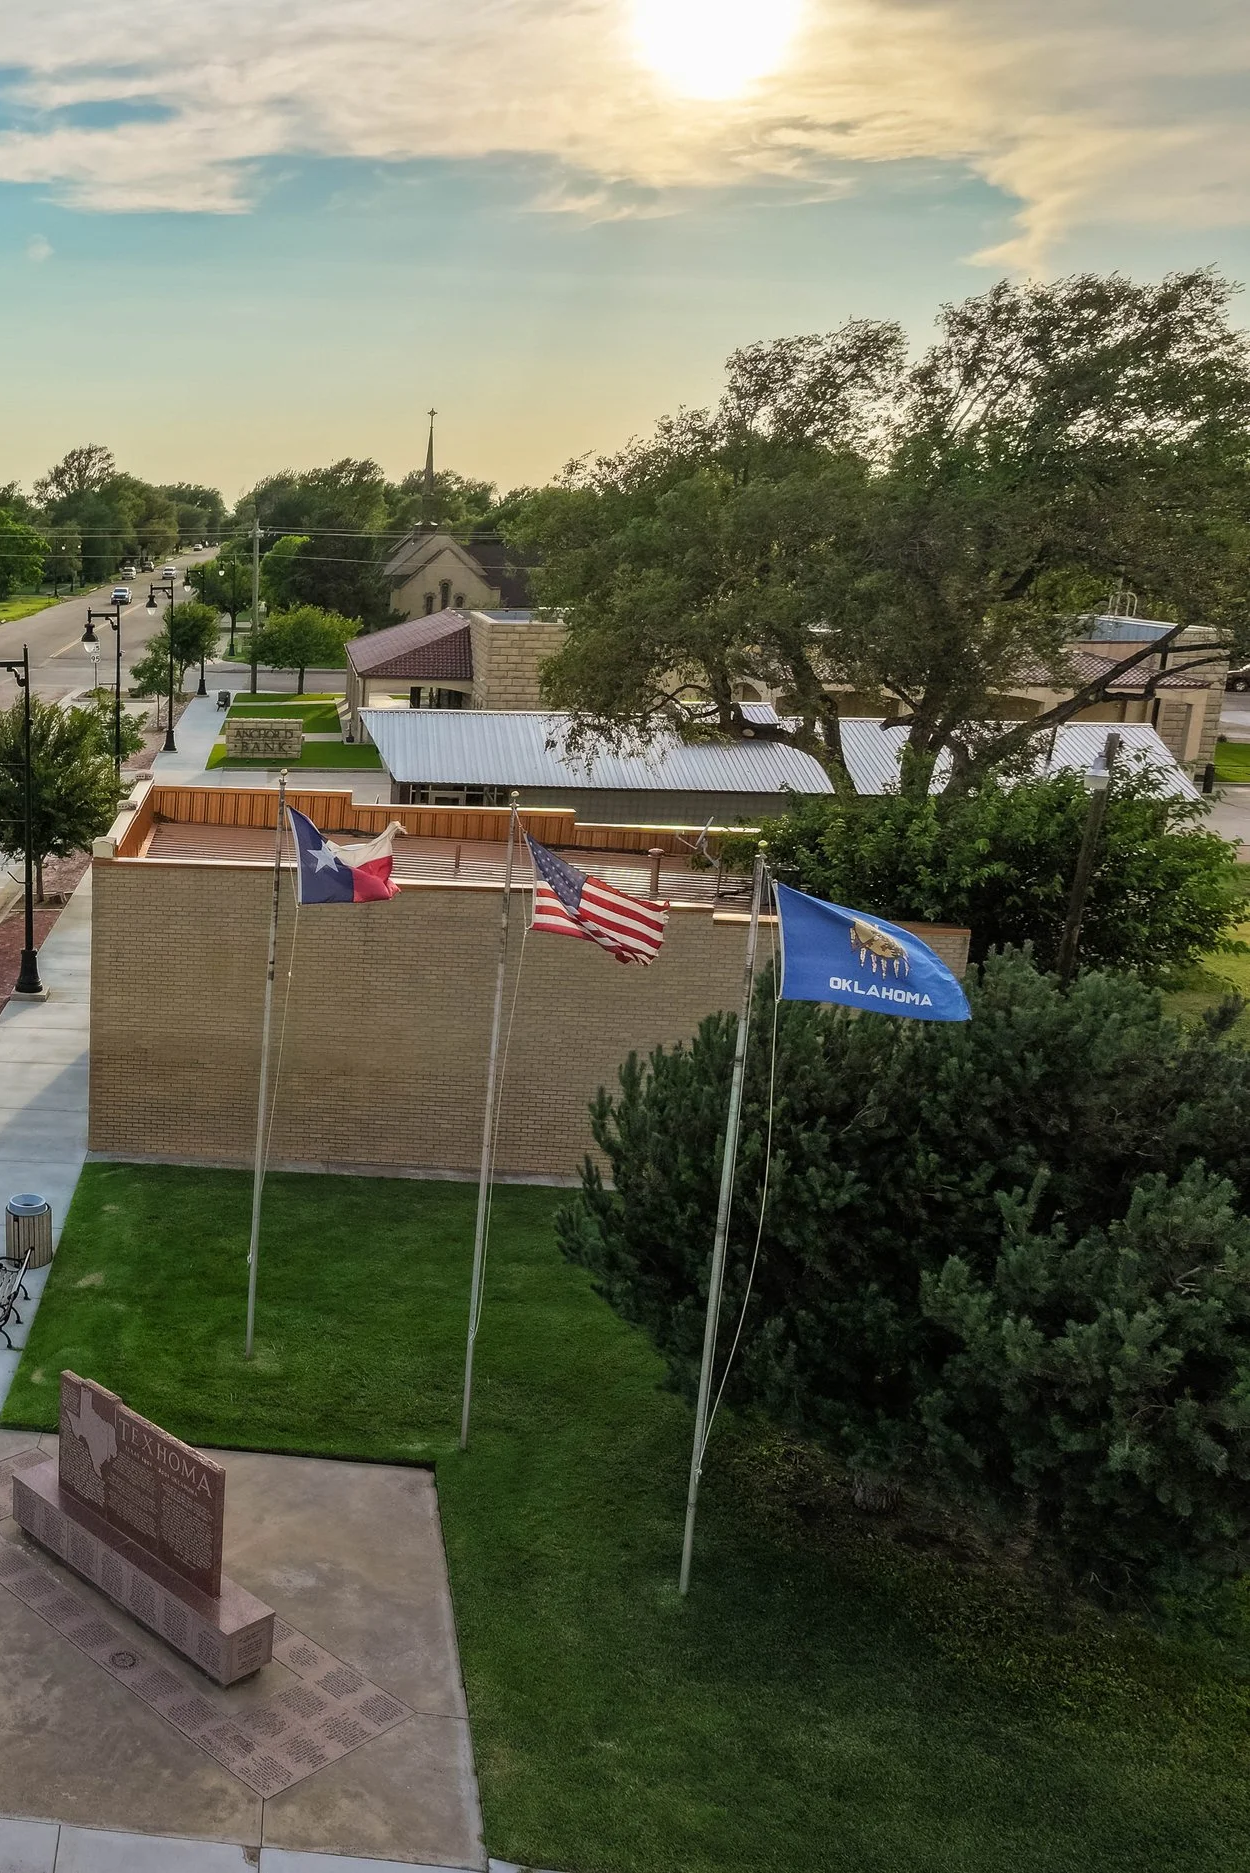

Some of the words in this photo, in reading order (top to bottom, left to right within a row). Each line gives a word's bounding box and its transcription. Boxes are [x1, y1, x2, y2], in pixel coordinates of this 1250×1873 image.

[91, 655, 100, 663] 95
[234, 728, 280, 739] ANCHOR
[241, 742, 287, 752] BANK
[829, 976, 933, 1007] OKLAHOMA
[118, 1418, 213, 1499] TEXHOMA
